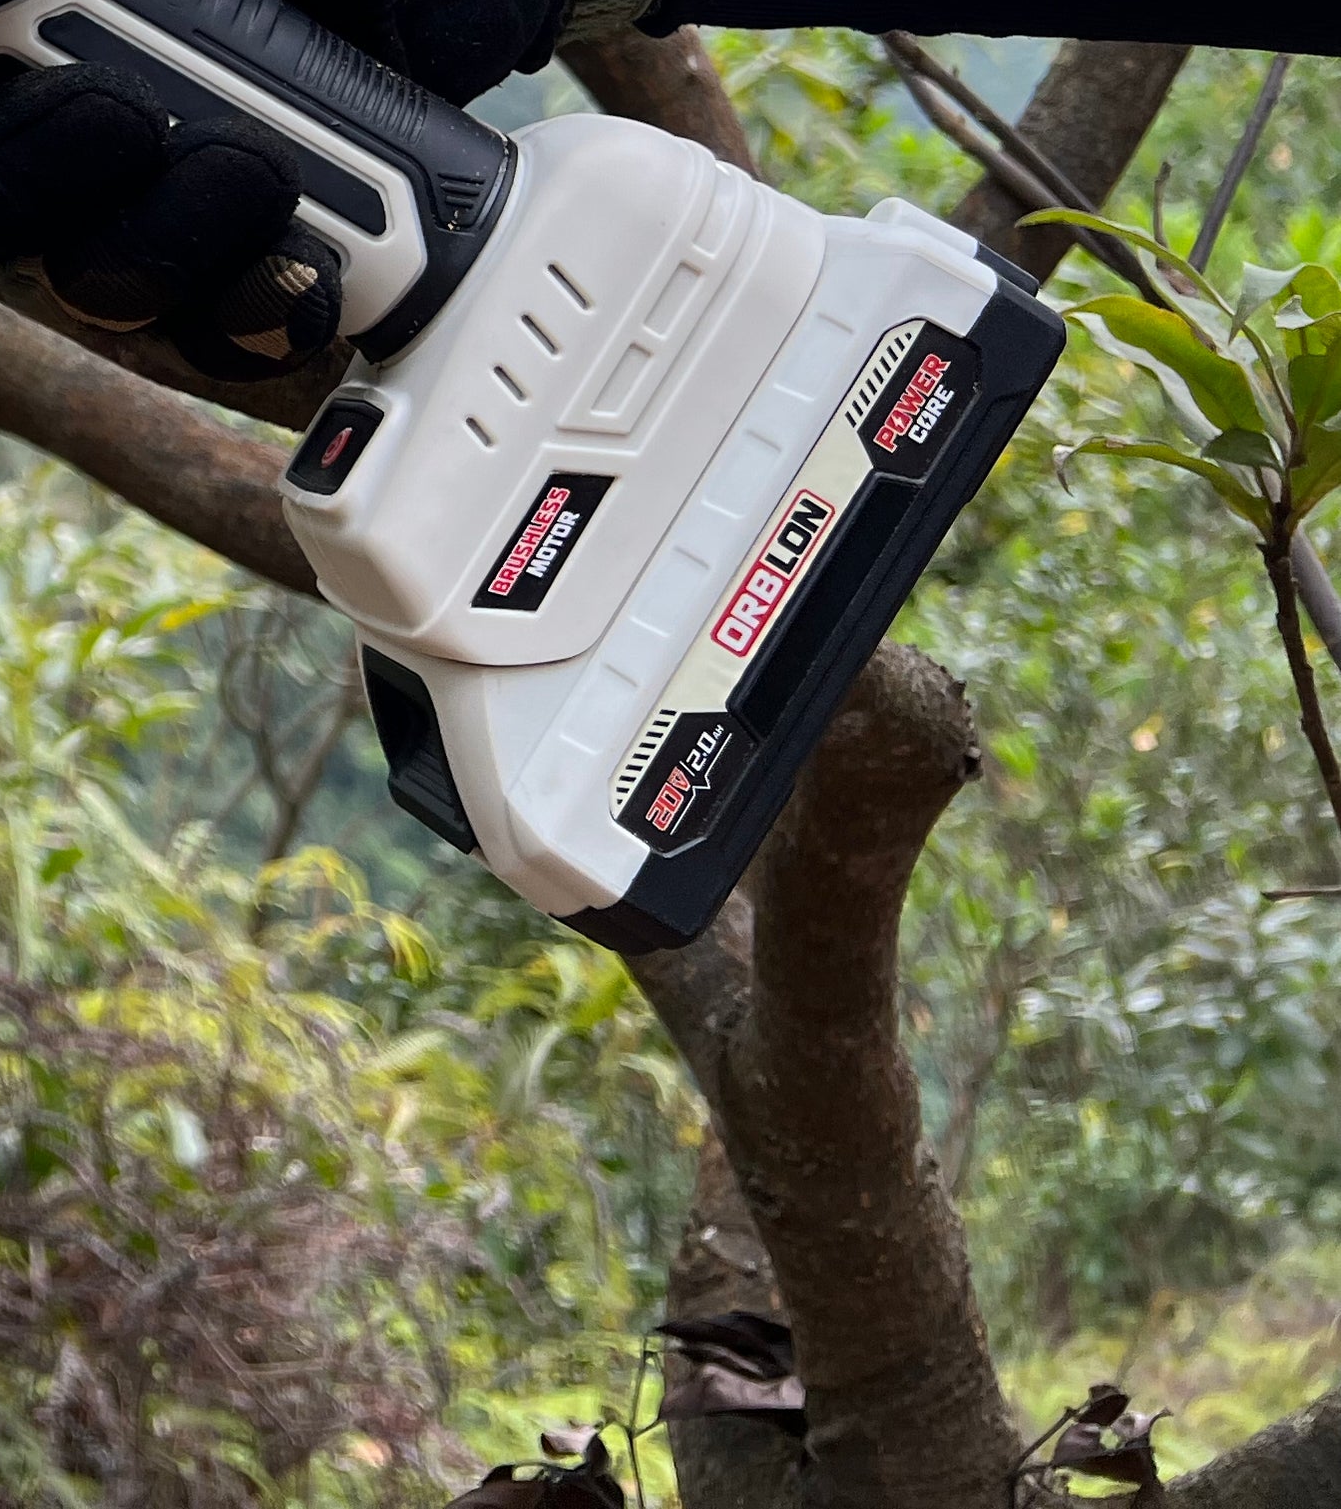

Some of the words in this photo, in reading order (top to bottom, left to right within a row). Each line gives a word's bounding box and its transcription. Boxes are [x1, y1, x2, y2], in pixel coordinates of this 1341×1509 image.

[873, 353, 952, 453] POWER
[908, 384, 955, 444] CORE
[488, 487, 570, 596] BRUSHLESS
[526, 510, 580, 578] MOTOR
[715, 497, 830, 653] ORBLON
